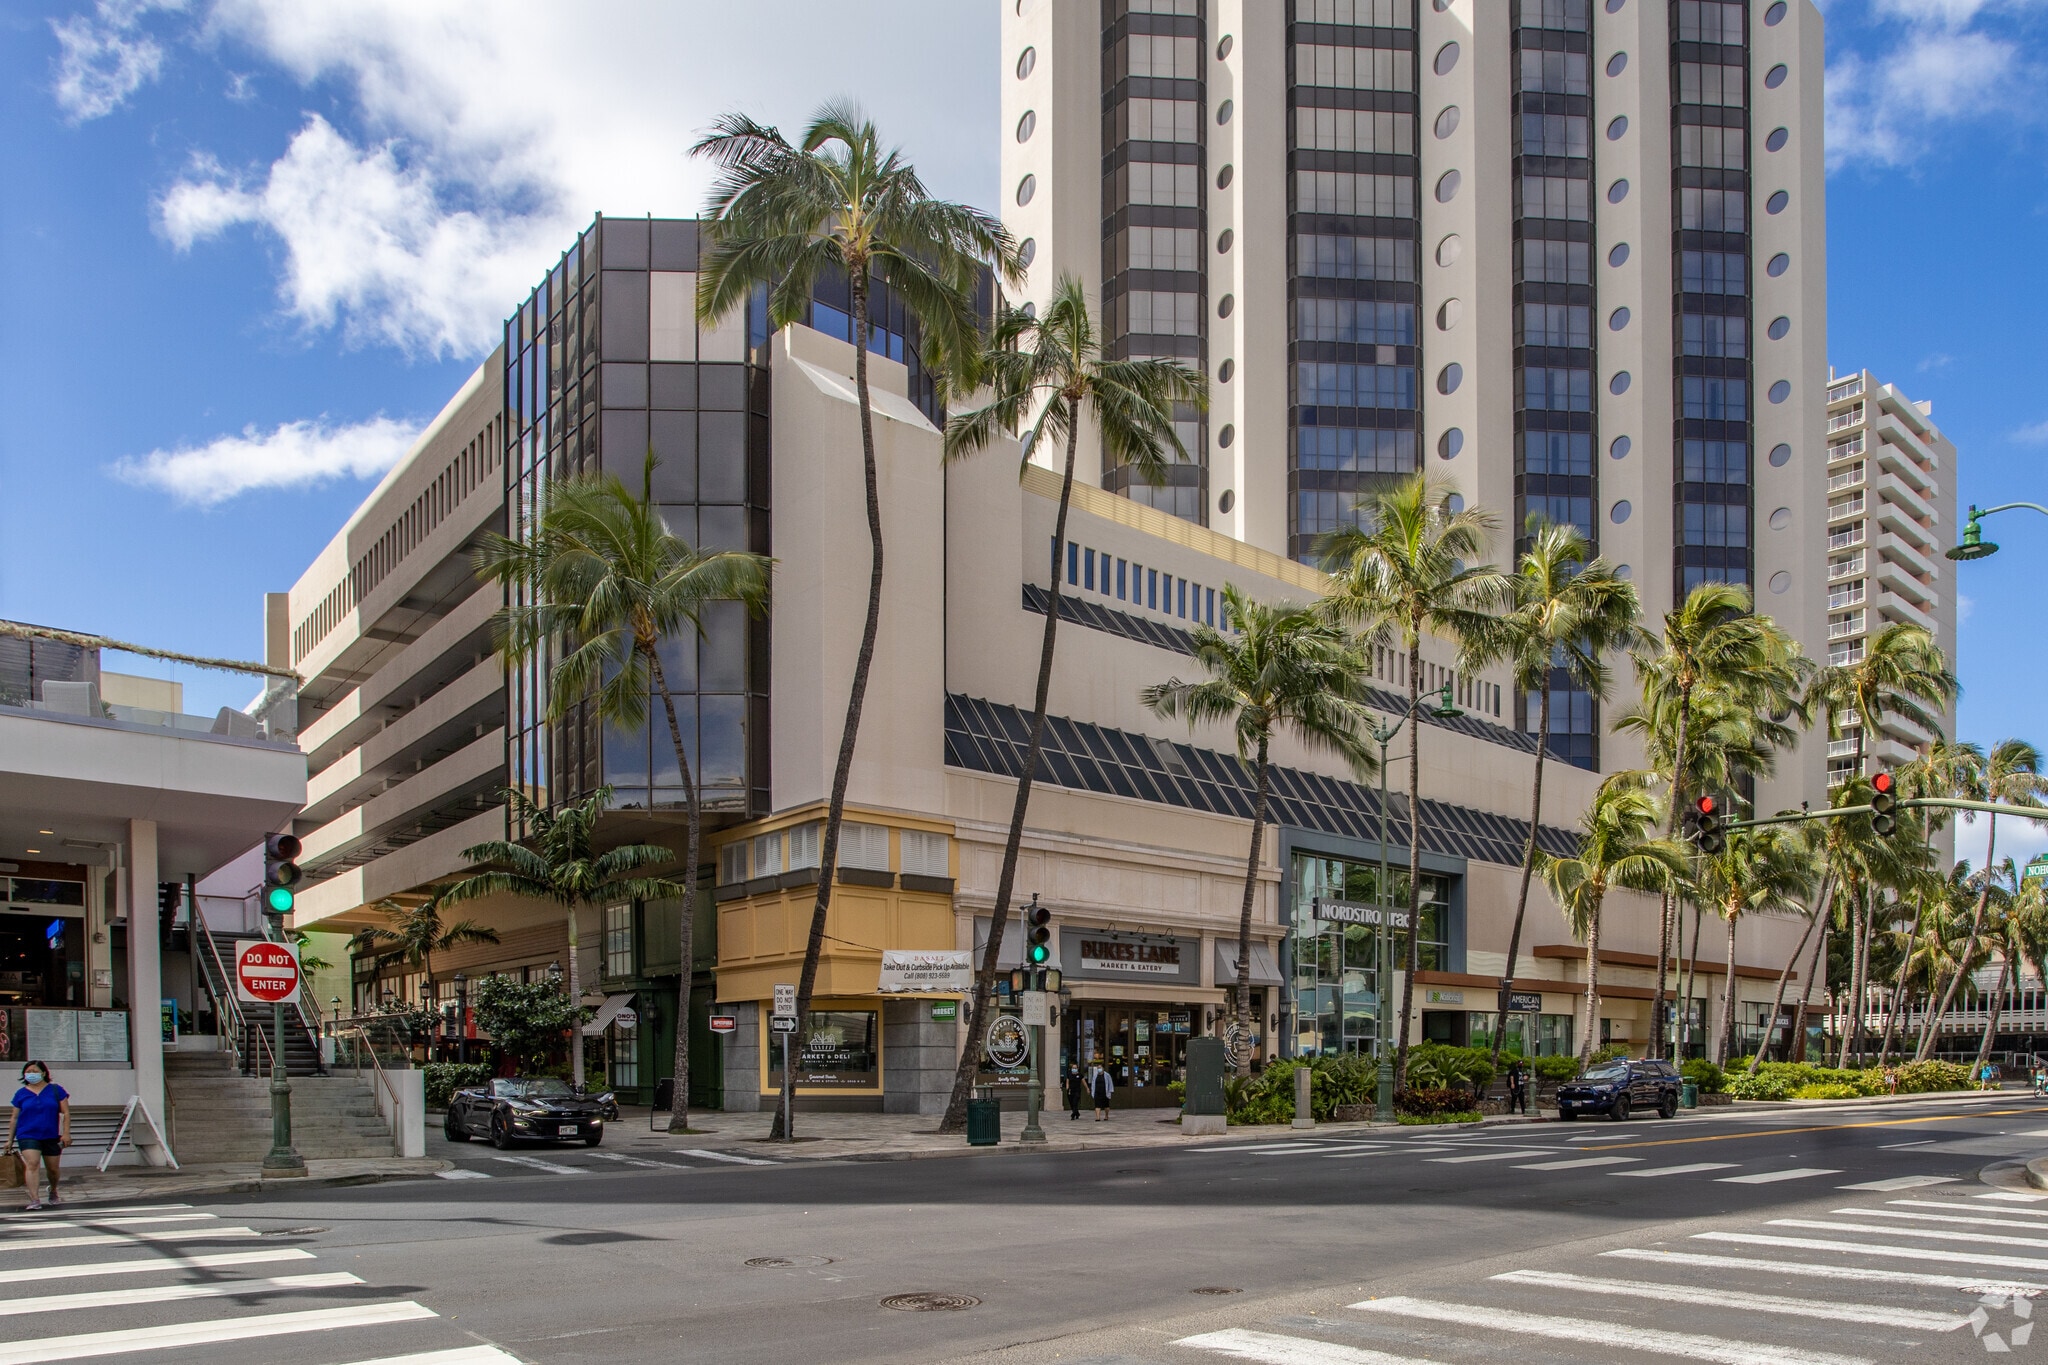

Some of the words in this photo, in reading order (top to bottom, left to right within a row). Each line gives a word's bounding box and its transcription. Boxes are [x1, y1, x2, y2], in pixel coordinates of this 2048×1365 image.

[1321, 903, 1389, 925] NORDSTRO
[1391, 912, 1419, 929] rac
[247, 953, 262, 963] DO
[268, 955, 289, 964] NOT
[1081, 940, 1135, 961] DUKES
[1139, 944, 1180, 964] LANE
[252, 980, 286, 990] ENTER
[1511, 995, 1540, 1004] AMERICAN
[991, 1021, 1010, 1040] BAKERY
[1013, 1023, 1025, 1041] SHOP
